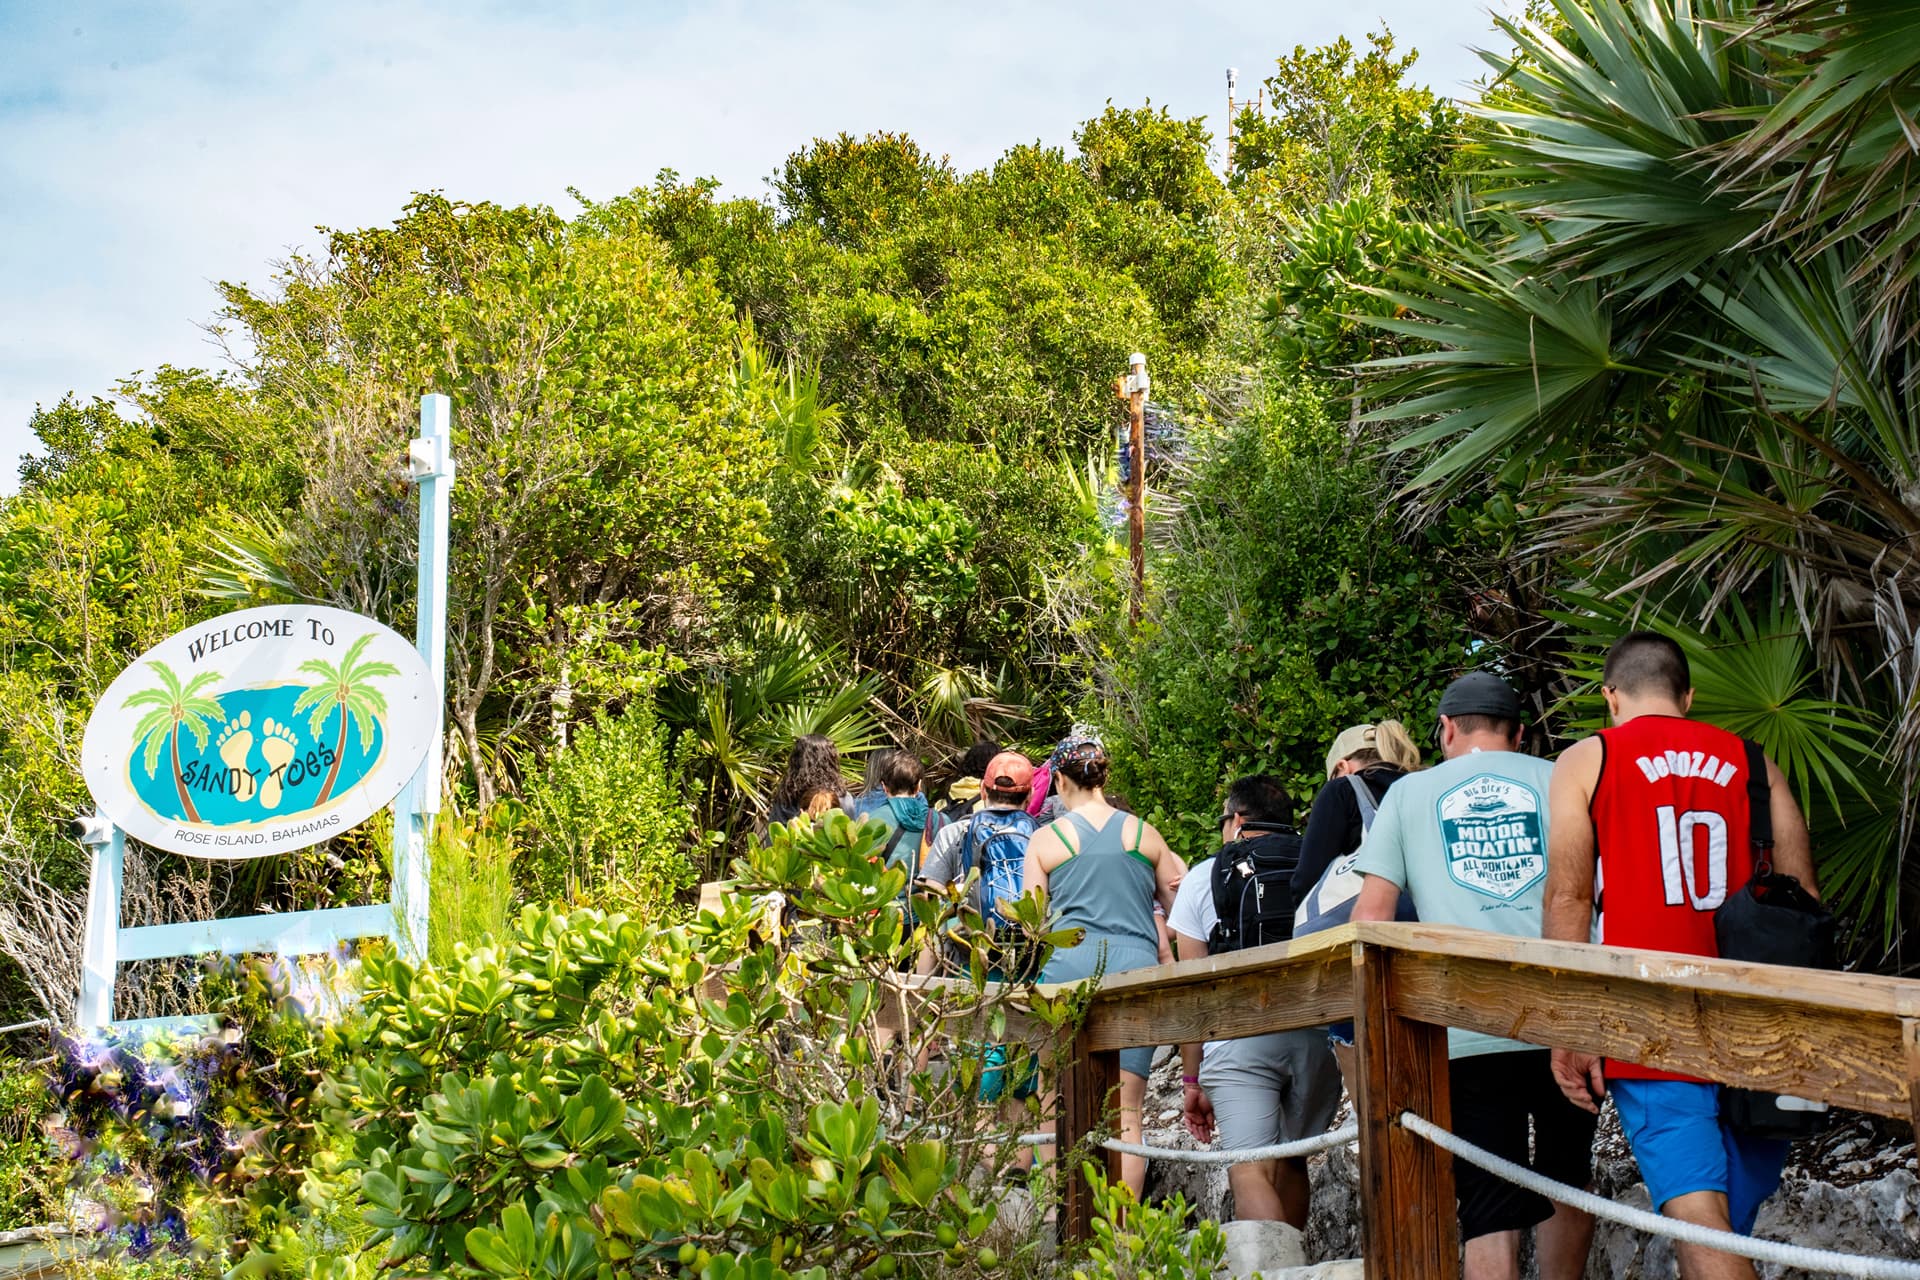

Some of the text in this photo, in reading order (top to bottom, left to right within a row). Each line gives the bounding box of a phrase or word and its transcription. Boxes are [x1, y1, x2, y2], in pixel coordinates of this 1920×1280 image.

[188, 619, 294, 662] WELCOME
[181, 760, 261, 795] SANDY
[1464, 787, 1479, 797] BIG
[174, 814, 341, 846] ROSE ISLAND, BAHAMAS
[1457, 822, 1526, 841] MOTOR
[1463, 860, 1479, 871] ALL
[1655, 805, 1728, 912] 10
